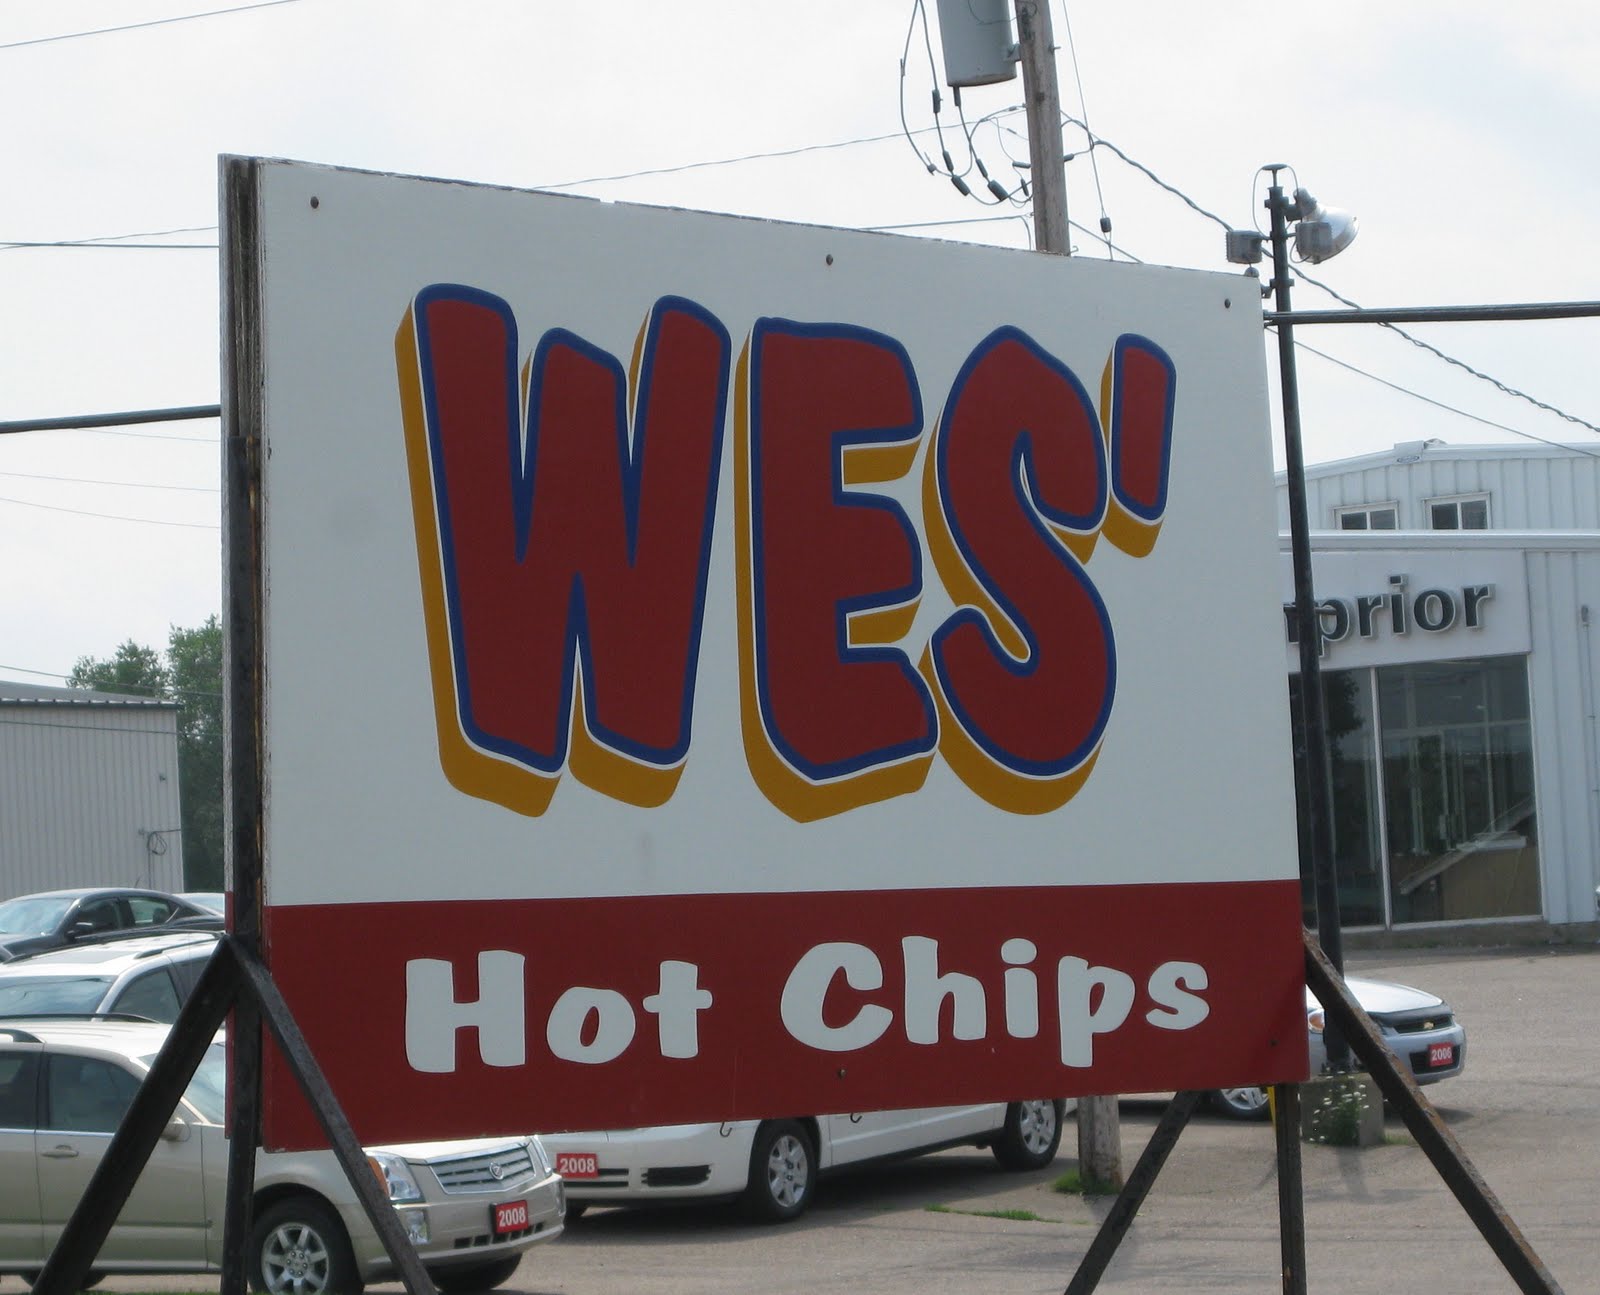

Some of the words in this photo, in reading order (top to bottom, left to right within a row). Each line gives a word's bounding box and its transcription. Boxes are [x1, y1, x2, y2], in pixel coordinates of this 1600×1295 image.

[395, 283, 1177, 823] WES'
[405, 950, 713, 1073] Hot
[780, 935, 1210, 1068] Chips
[559, 1157, 596, 1174] 2008
[498, 1206, 526, 1227] 2008
